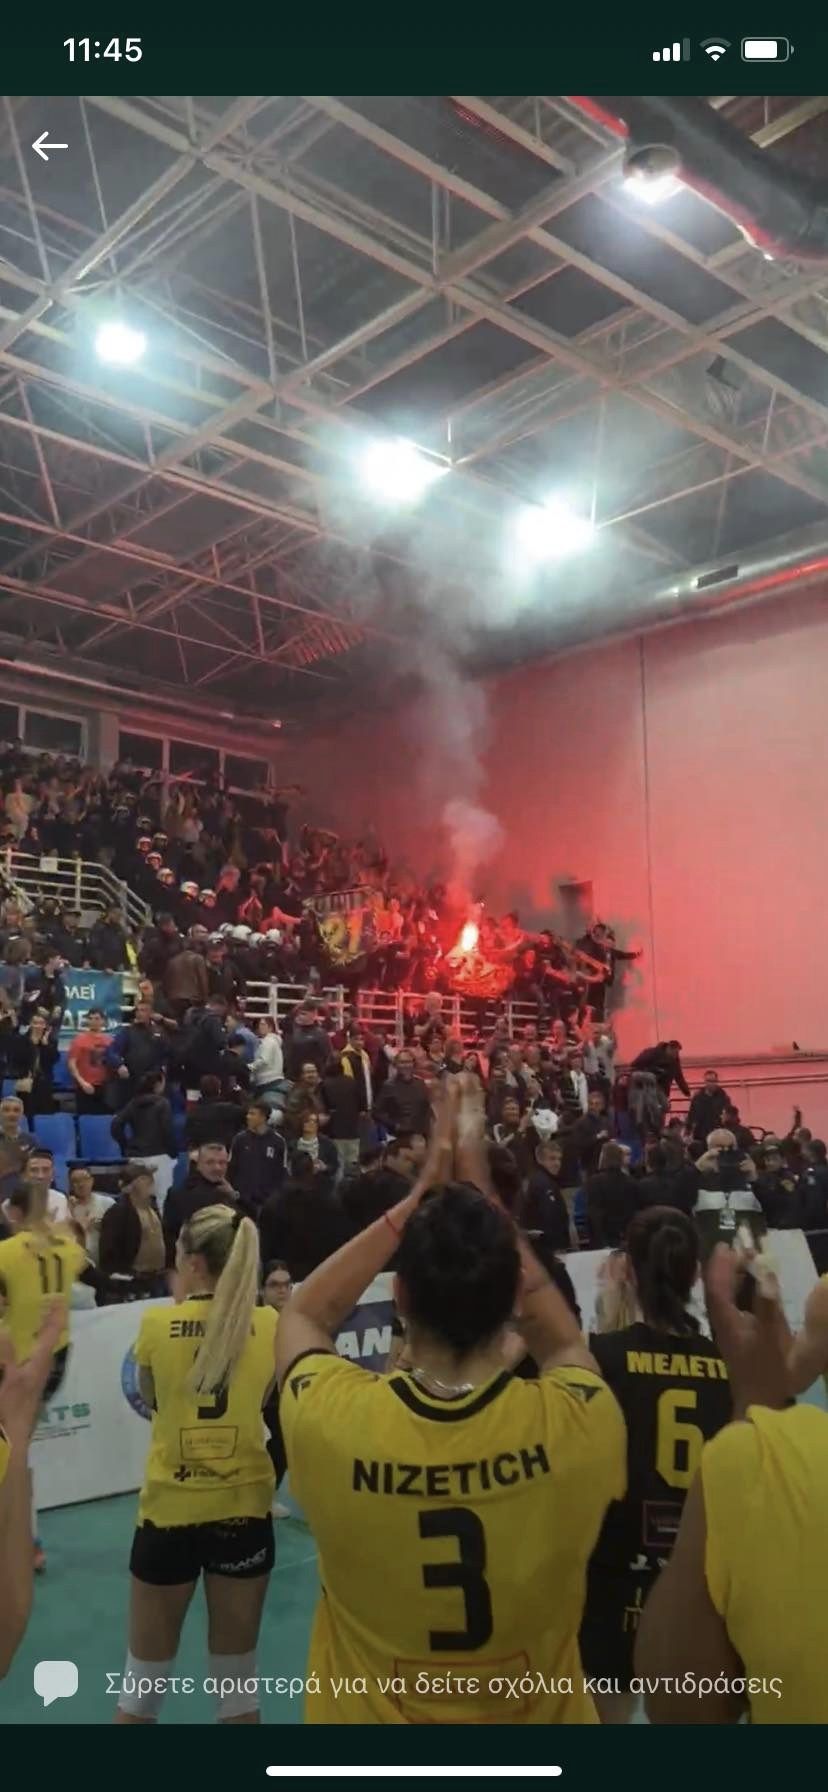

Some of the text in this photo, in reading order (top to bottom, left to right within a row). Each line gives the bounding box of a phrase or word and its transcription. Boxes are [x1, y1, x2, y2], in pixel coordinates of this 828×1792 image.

[353, 1444, 550, 1497] NIZETICH
[656, 1388, 704, 1489] 6
[418, 1506, 494, 1653] 3
